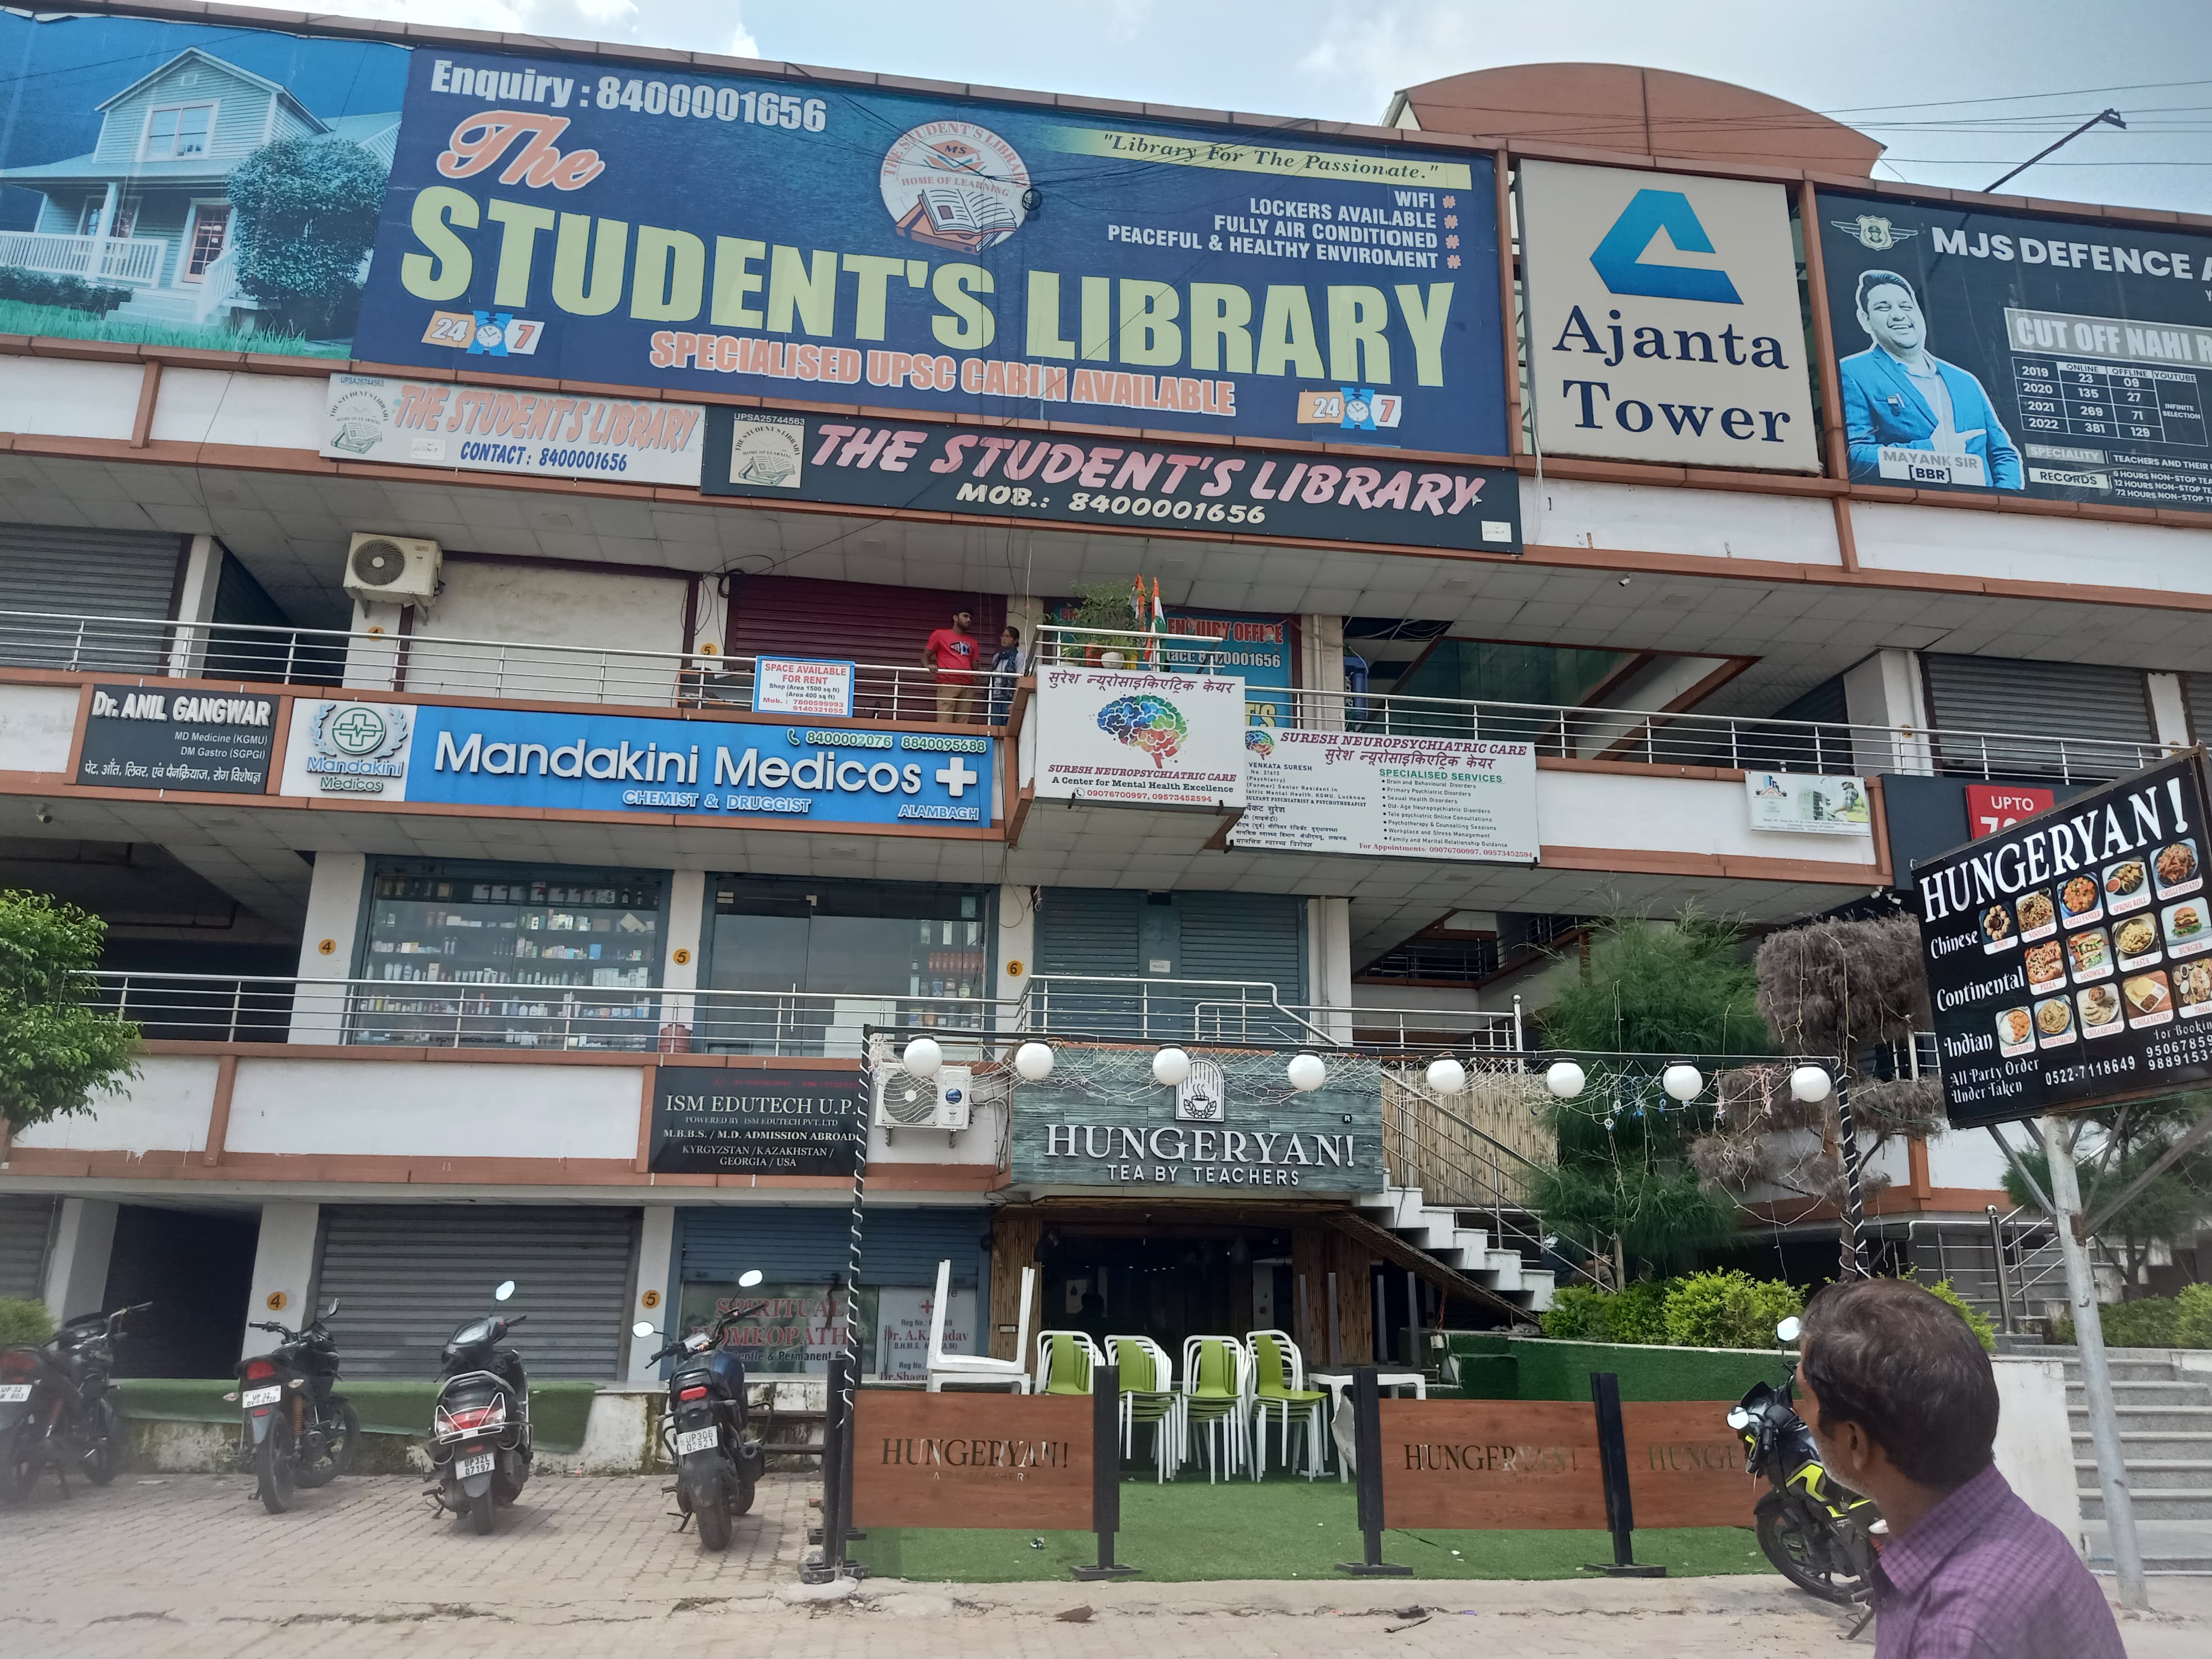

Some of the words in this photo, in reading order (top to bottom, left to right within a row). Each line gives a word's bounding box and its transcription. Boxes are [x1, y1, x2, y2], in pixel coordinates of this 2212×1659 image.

[431, 60, 573, 109] Enquiry
[597, 75, 828, 133] 8400001656
[436, 110, 606, 191] The
[945, 145, 967, 154] MS
[1207, 146, 1243, 163] For
[1254, 149, 1295, 168] The
[883, 149, 902, 176] THE
[902, 176, 934, 186] HOME
[937, 176, 951, 185] OF
[954, 176, 1009, 196] LEARNING
[1394, 191, 1436, 209] WIFI
[1250, 197, 1332, 220] LOCKERS
[1338, 206, 1437, 229] AVAILABLE
[1214, 215, 1269, 235] FULLY
[1274, 220, 1305, 238] AIR
[1312, 224, 1438, 249] CONDITIONED
[1108, 225, 1202, 249] PEACEFUL
[1229, 236, 1311, 259] HEALTHY
[1317, 243, 1438, 269] ENVIROMENT
[1932, 227, 2014, 261] MJS
[2019, 237, 2193, 279] DEFENCE
[401, 186, 997, 351] STUDENT'S
[1026, 270, 1455, 387] LIBRARY
[517, 324, 534, 351] 7
[1552, 305, 1789, 369] Ajanta
[2017, 317, 2068, 348] CUT
[2074, 322, 2120, 354] OFF
[2126, 327, 2193, 361] NAHI
[649, 332, 862, 386] SPECIALISED
[865, 349, 956, 392] UPSC
[1072, 367, 1237, 418] AVAILABLE
[2022, 366, 2049, 377] 2019
[2078, 373, 2093, 384] 23
[2123, 377, 2140, 388] 09
[2067, 363, 2099, 373] ONLINE
[2112, 368, 2148, 378] OFFLINE
[2154, 371, 2197, 382] YOUTUBE
[2023, 382, 2053, 394] 2020
[2078, 387, 2099, 399] 135
[2127, 392, 2141, 403] 27
[1379, 399, 1395, 424] 7
[1563, 379, 1791, 443] Tower
[2027, 400, 2056, 413] 2021
[2080, 405, 2103, 417] 269
[2131, 410, 2144, 420] 71
[2162, 410, 2201, 420] SELECTION
[2164, 403, 2195, 411] INFINITE
[394, 384, 450, 430] THE
[446, 390, 597, 442] STUDENT'S
[589, 402, 700, 453] LIBRARY
[734, 413, 805, 425] UPSA25744563
[2028, 418, 2060, 430] 2022
[2085, 422, 2106, 434] 381
[2130, 426, 2151, 437] 129
[539, 447, 627, 472] 8400001656
[1883, 451, 1952, 466] MAYANK
[1955, 457, 1978, 469] SIR
[2030, 446, 2099, 461] SPECIALITY
[2113, 454, 2160, 466] TEACHERS
[2161, 458, 2182, 468] AND
[811, 425, 928, 473] THE
[930, 435, 1245, 497] STUDENT'S
[1249, 461, 1486, 516] LIBRARY
[2039, 471, 2098, 486] RECORDS
[1068, 492, 1266, 524] 8400001656
[765, 663, 794, 672] SPACE
[797, 665, 846, 676] AVAILABLE
[782, 674, 801, 684] FOR
[804, 676, 828, 685] RENT
[1048, 670, 1080, 689] सुरेश
[1203, 680, 1236, 694] केयर
[92, 691, 119, 718] Dr.
[121, 693, 167, 721] ANIL
[173, 696, 271, 727] GANGWAR
[175, 732, 189, 742] MD
[191, 732, 231, 744] Medicine
[233, 733, 268, 746] (KGMU)
[806, 731, 894, 749] 8400002076
[901, 735, 987, 754] 8840095688
[1280, 731, 1339, 745] SURESH
[1340, 735, 1487, 754] NEUROPSYCHIATRIC
[1489, 745, 1527, 757] CARE
[181, 746, 195, 757] DM
[197, 747, 228, 759] Gastro
[229, 748, 265, 761] (SGPGI)
[433, 731, 700, 785] Mandakini
[713, 745, 922, 795] Medicos
[1324, 747, 1355, 765] सुरेश
[1465, 754, 1496, 769] केयर
[213, 766, 229, 782] रोग
[306, 756, 404, 778] Mandakini
[1048, 764, 1094, 776] SURESH
[1095, 766, 1206, 781] NEUROPSYCHIATRIC
[1207, 773, 1237, 782] CARE
[1379, 769, 1448, 780] SPECIALISED
[1451, 773, 1503, 783] SERVICES
[320, 776, 384, 793] Medicos
[1061, 778, 1093, 786] Center
[1095, 778, 1110, 787] for
[1112, 780, 1146, 790] Mental
[1149, 782, 1182, 791] Health
[1183, 784, 1234, 793] Excellence
[623, 790, 700, 810] CHEMIST
[726, 794, 812, 815] DRUGGIST
[898, 803, 980, 822] ALAMBAGH
[1991, 795, 2034, 812] UPTO
[1920, 777, 2189, 924] HUNGERYAN!
[322, 941, 332, 953] 4
[1931, 930, 1979, 959] Chinese
[2179, 942, 2204, 955] BURGER
[676, 949, 688, 965] 5
[2132, 958, 2150, 968] PASTA
[1009, 961, 1020, 977] 6
[2080, 968, 2106, 979] SANDWICH
[1937, 965, 2025, 1012] Continental
[2039, 981, 2056, 992] PIZZA
[1944, 1032, 1993, 1058] Indian
[1969, 1066, 2002, 1083] Party
[2005, 1058, 2039, 1076] Order
[1952, 1086, 1986, 1103] Under
[1987, 1079, 2023, 1098] Taken
[665, 1094, 705, 1111] ISM
[711, 1095, 813, 1115] EDUTECH
[686, 1116, 728, 1125] POWERED
[761, 1118, 801, 1126] EDUTECH
[744, 1130, 808, 1141] ADMISSION
[810, 1132, 857, 1141] ABROAD
[1045, 1123, 1355, 1167] HUNGERYAN!
[682, 1145, 750, 1155] KYRGYZSTAN
[719, 1157, 767, 1167] GEORGIA
[777, 1158, 797, 1167] USA
[1108, 1164, 1145, 1181] TEA
[1155, 1165, 1178, 1182] BY
[1192, 1166, 1300, 1186] TEACHERS
[270, 1295, 280, 1308] 4
[646, 1292, 656, 1306] 5
[779, 1351, 833, 1361] Permanent
